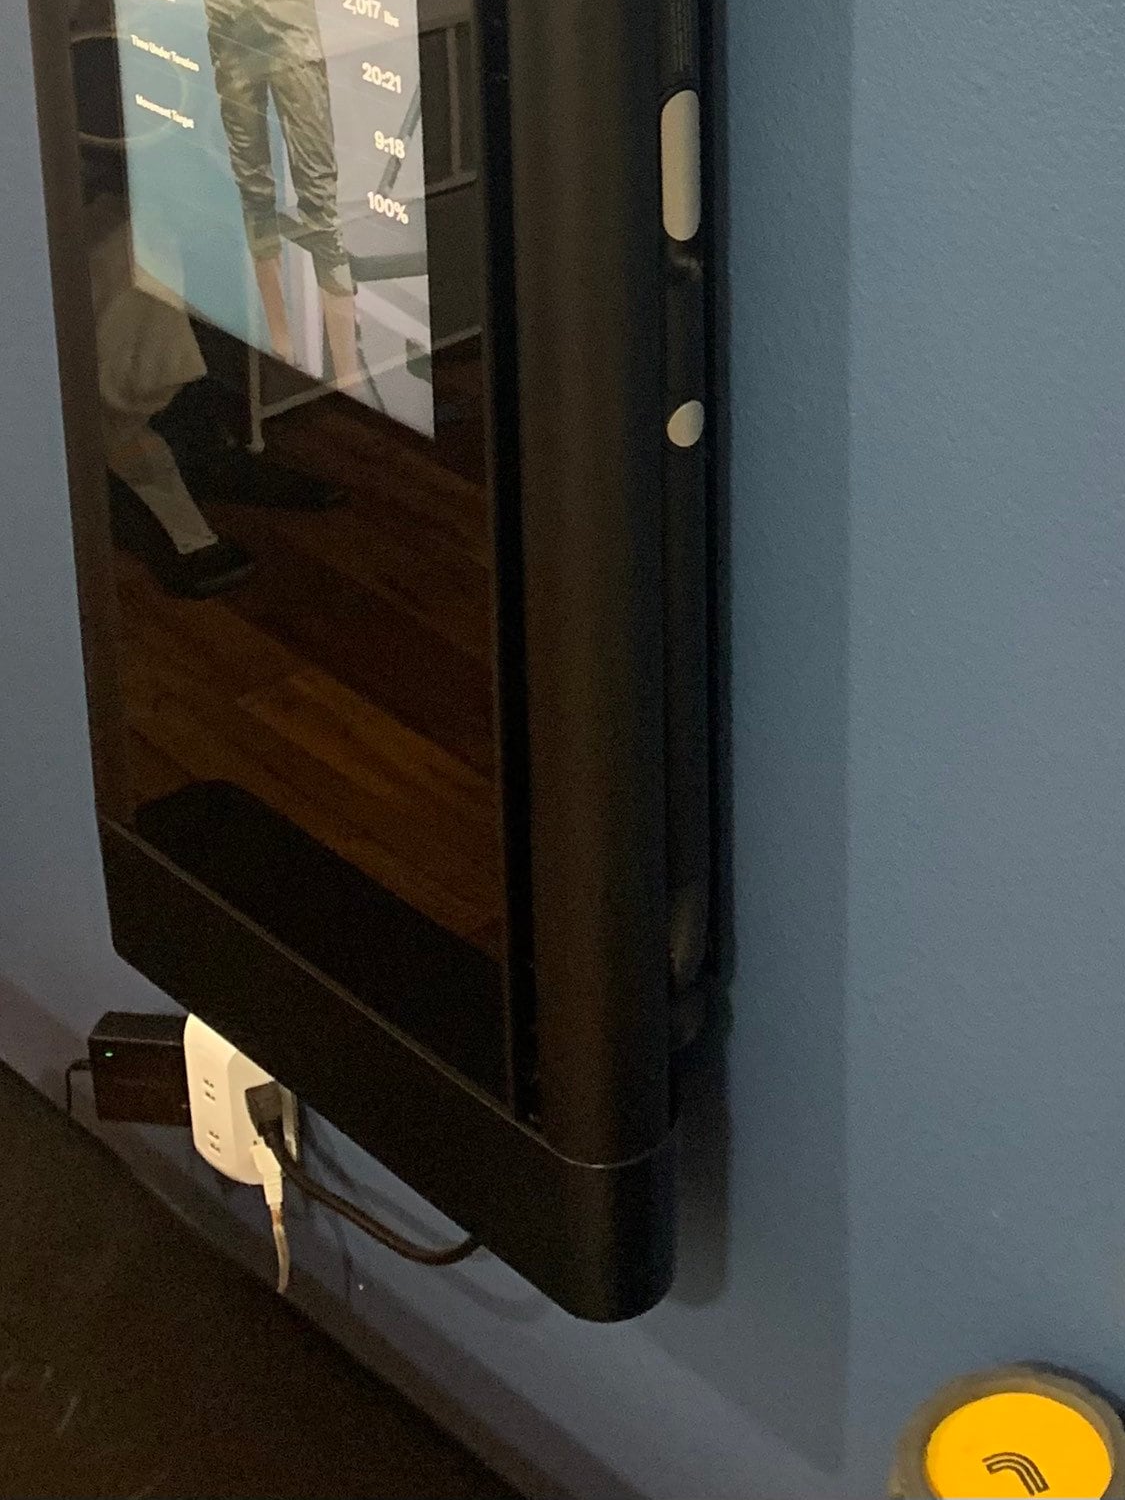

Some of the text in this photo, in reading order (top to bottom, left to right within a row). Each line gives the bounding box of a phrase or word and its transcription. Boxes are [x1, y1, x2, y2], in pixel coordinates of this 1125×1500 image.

[361, 61, 402, 94] 20:21
[374, 130, 405, 159] 9:18
[367, 191, 409, 225] 100%
